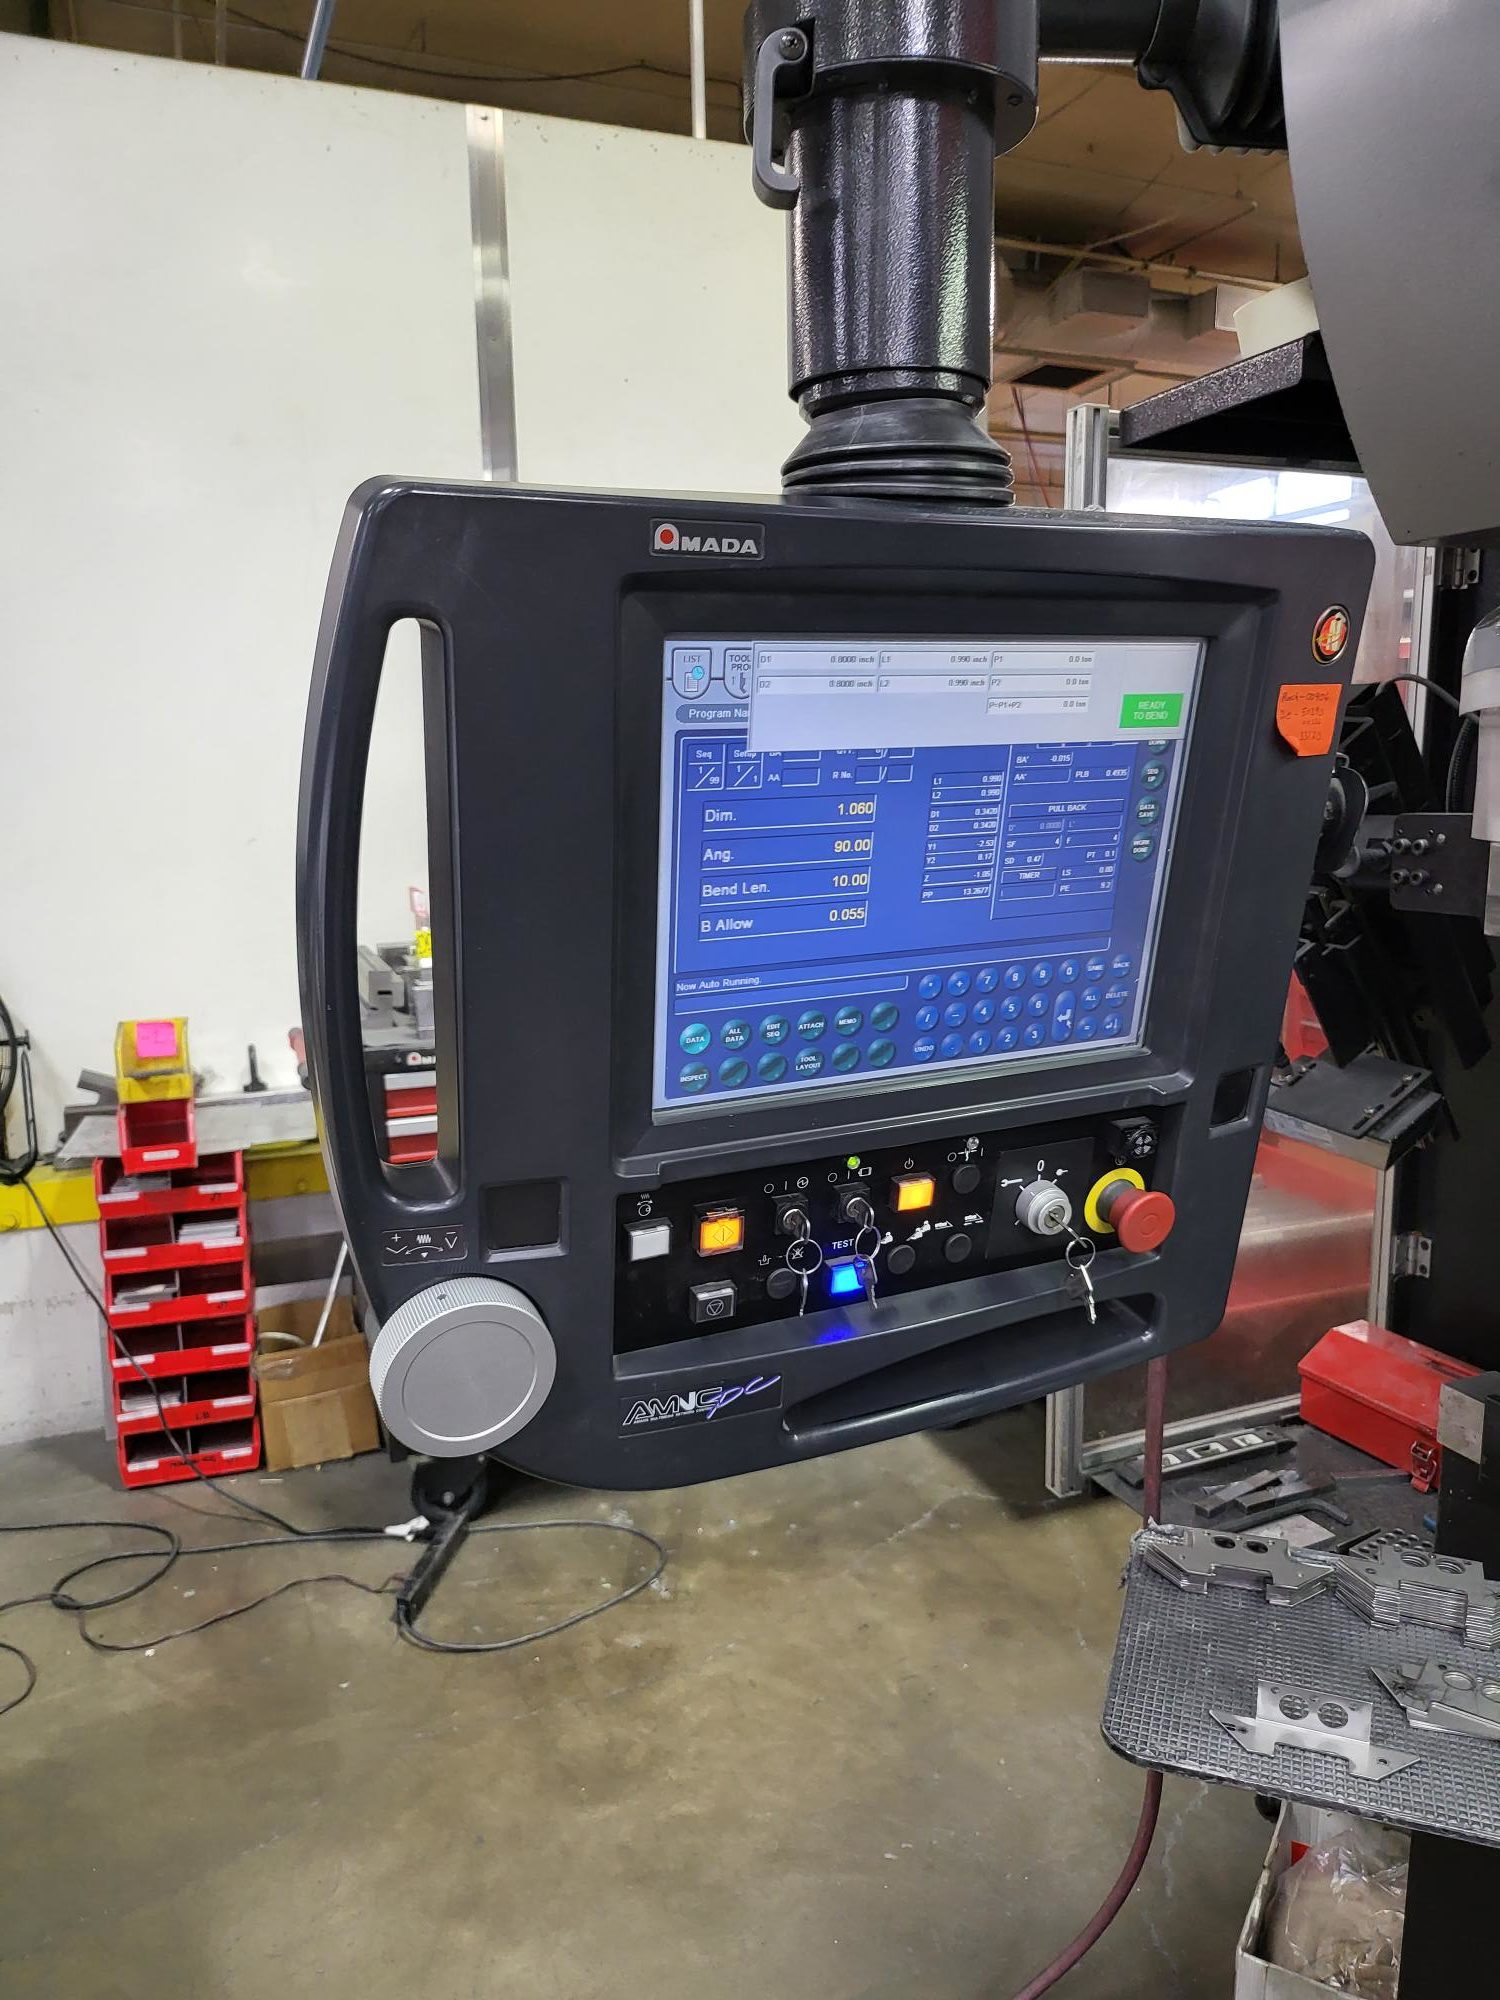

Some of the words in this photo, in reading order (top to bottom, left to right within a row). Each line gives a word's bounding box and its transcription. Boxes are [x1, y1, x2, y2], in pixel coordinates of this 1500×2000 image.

[654, 523, 758, 554] AMADA
[1138, 701, 1166, 709] READY
[689, 709, 731, 720] Program
[734, 709, 748, 718] Na
[1134, 711, 1144, 720] TO
[1145, 711, 1168, 720] BEND
[696, 750, 712, 759] Seq
[709, 776, 720, 784] 99
[838, 802, 873, 815] 1.060
[705, 810, 736, 822] Dim.
[834, 839, 870, 853] 90.00
[703, 848, 734, 862] Ang.
[833, 874, 868, 887] 10.00
[702, 883, 737, 897] Bend
[743, 882, 770, 894] Len.
[830, 908, 864, 921] 0.055
[701, 921, 711, 932] B
[716, 919, 753, 931] Allow
[1040, 970, 1046, 978] 9
[1066, 967, 1072, 975] 0
[984, 976, 991, 984] 7
[1012, 973, 1018, 981] 8
[676, 984, 696, 992] Now
[699, 981, 720, 989] Auto
[980, 1007, 986, 1015] 4
[1008, 1004, 1015, 1012] 5
[798, 1022, 824, 1030] ATTACH
[766, 1030, 780, 1038] SEQ
[1005, 1034, 1011, 1042] 2
[686, 1036, 705, 1044] DATA
[978, 1038, 982, 1046] 1
[796, 1062, 820, 1070] LAYOUT
[680, 1073, 707, 1082] INSPECT
[832, 1239, 854, 1250] TEST
